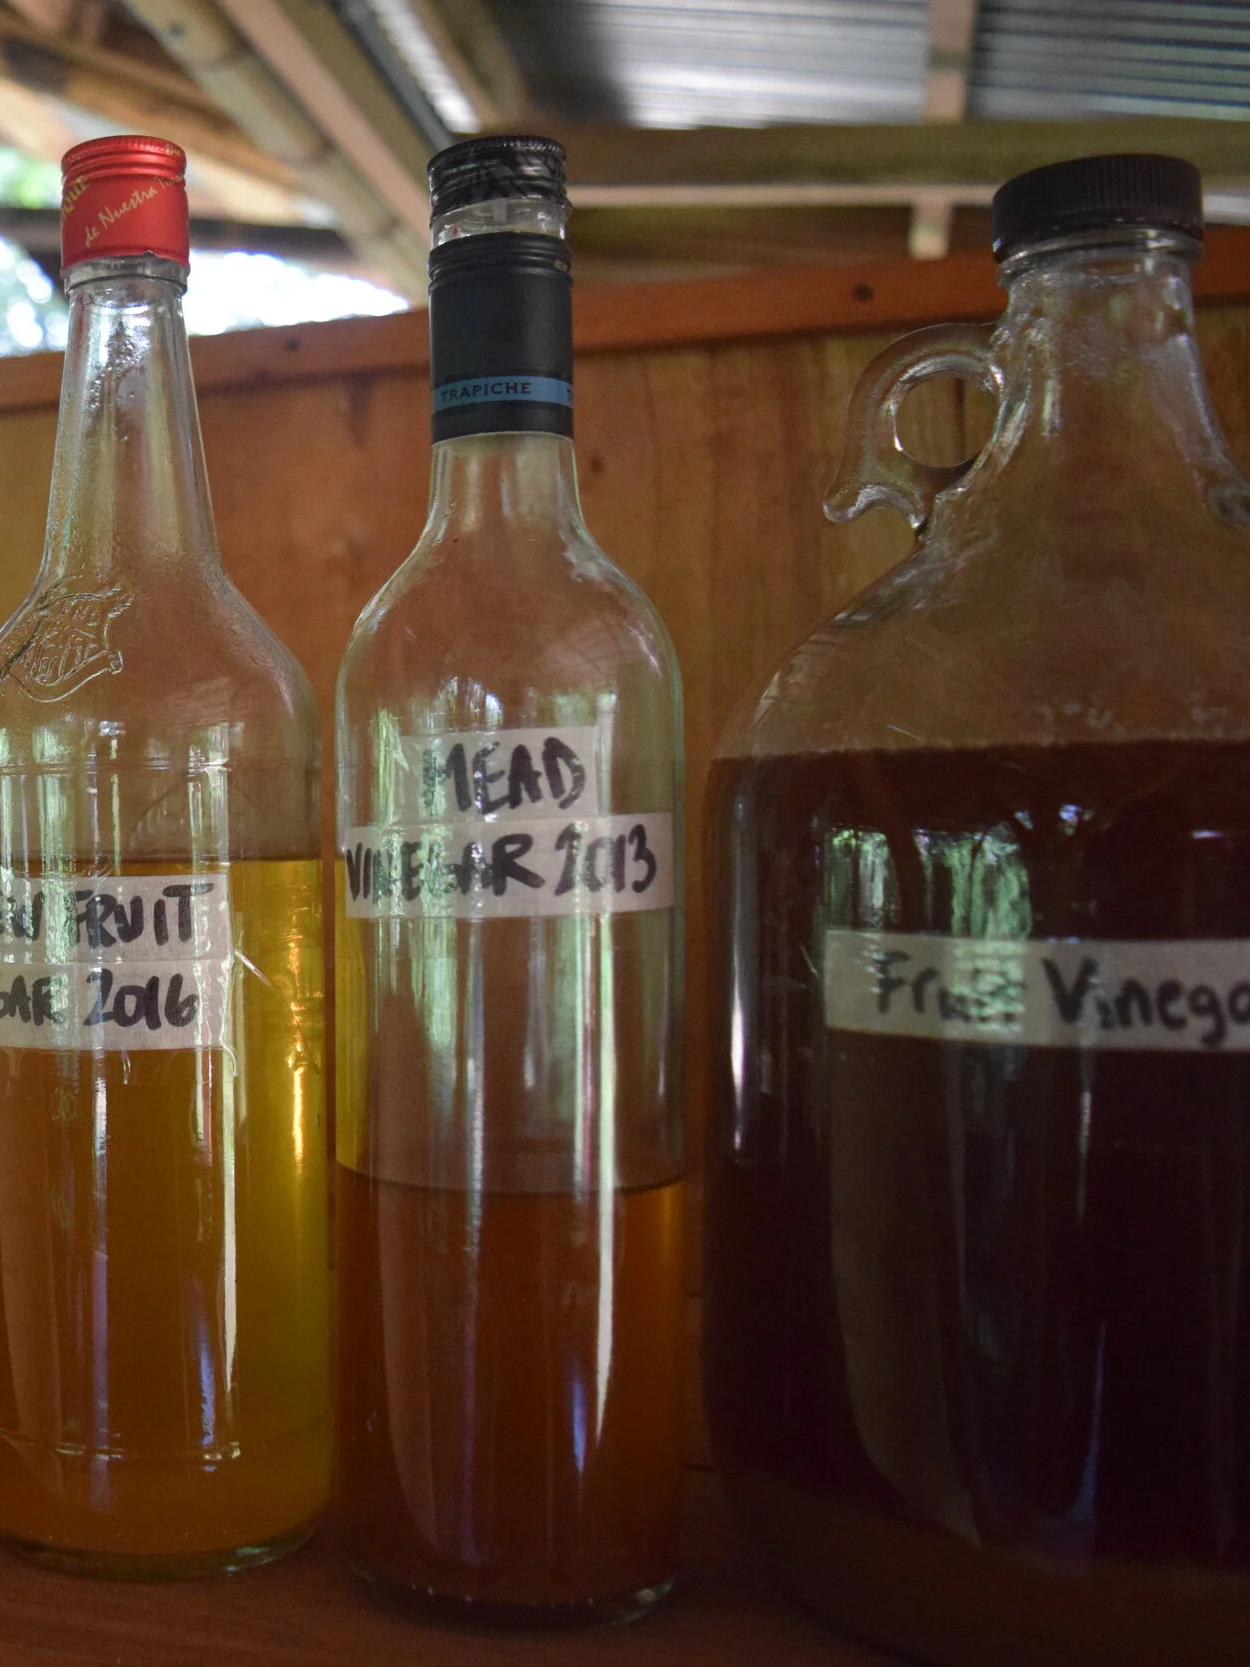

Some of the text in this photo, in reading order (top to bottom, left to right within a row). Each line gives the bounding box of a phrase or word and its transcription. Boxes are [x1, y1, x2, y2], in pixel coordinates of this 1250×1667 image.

[98, 185, 158, 229] Nuestra
[441, 382, 532, 402] TRAPICHE
[554, 823, 658, 897] 2013
[66, 882, 214, 949] FRUIT
[82, 967, 199, 1031] 2016
